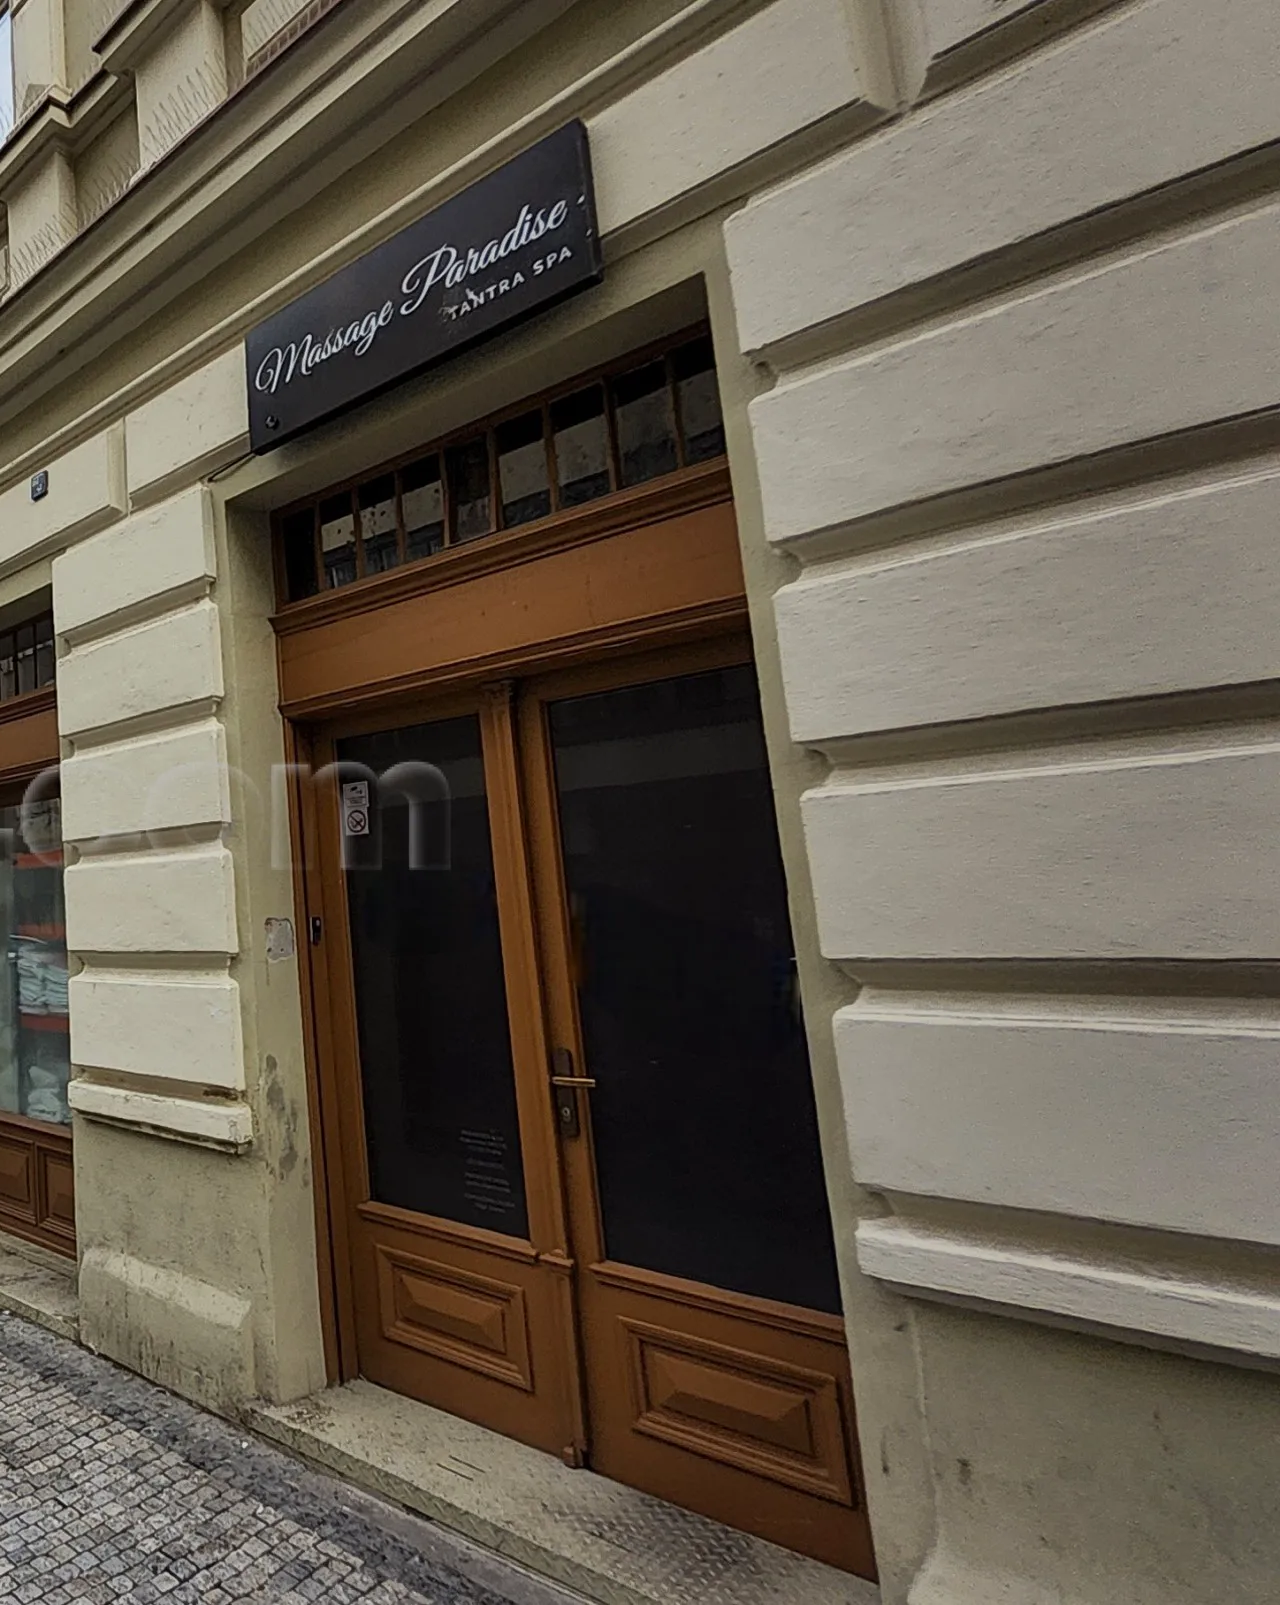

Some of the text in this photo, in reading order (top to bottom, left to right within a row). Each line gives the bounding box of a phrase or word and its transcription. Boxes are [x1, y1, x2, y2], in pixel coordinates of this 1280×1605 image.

[254, 198, 568, 393] Massage Paradise
[447, 245, 572, 321] TANTRA SPA
